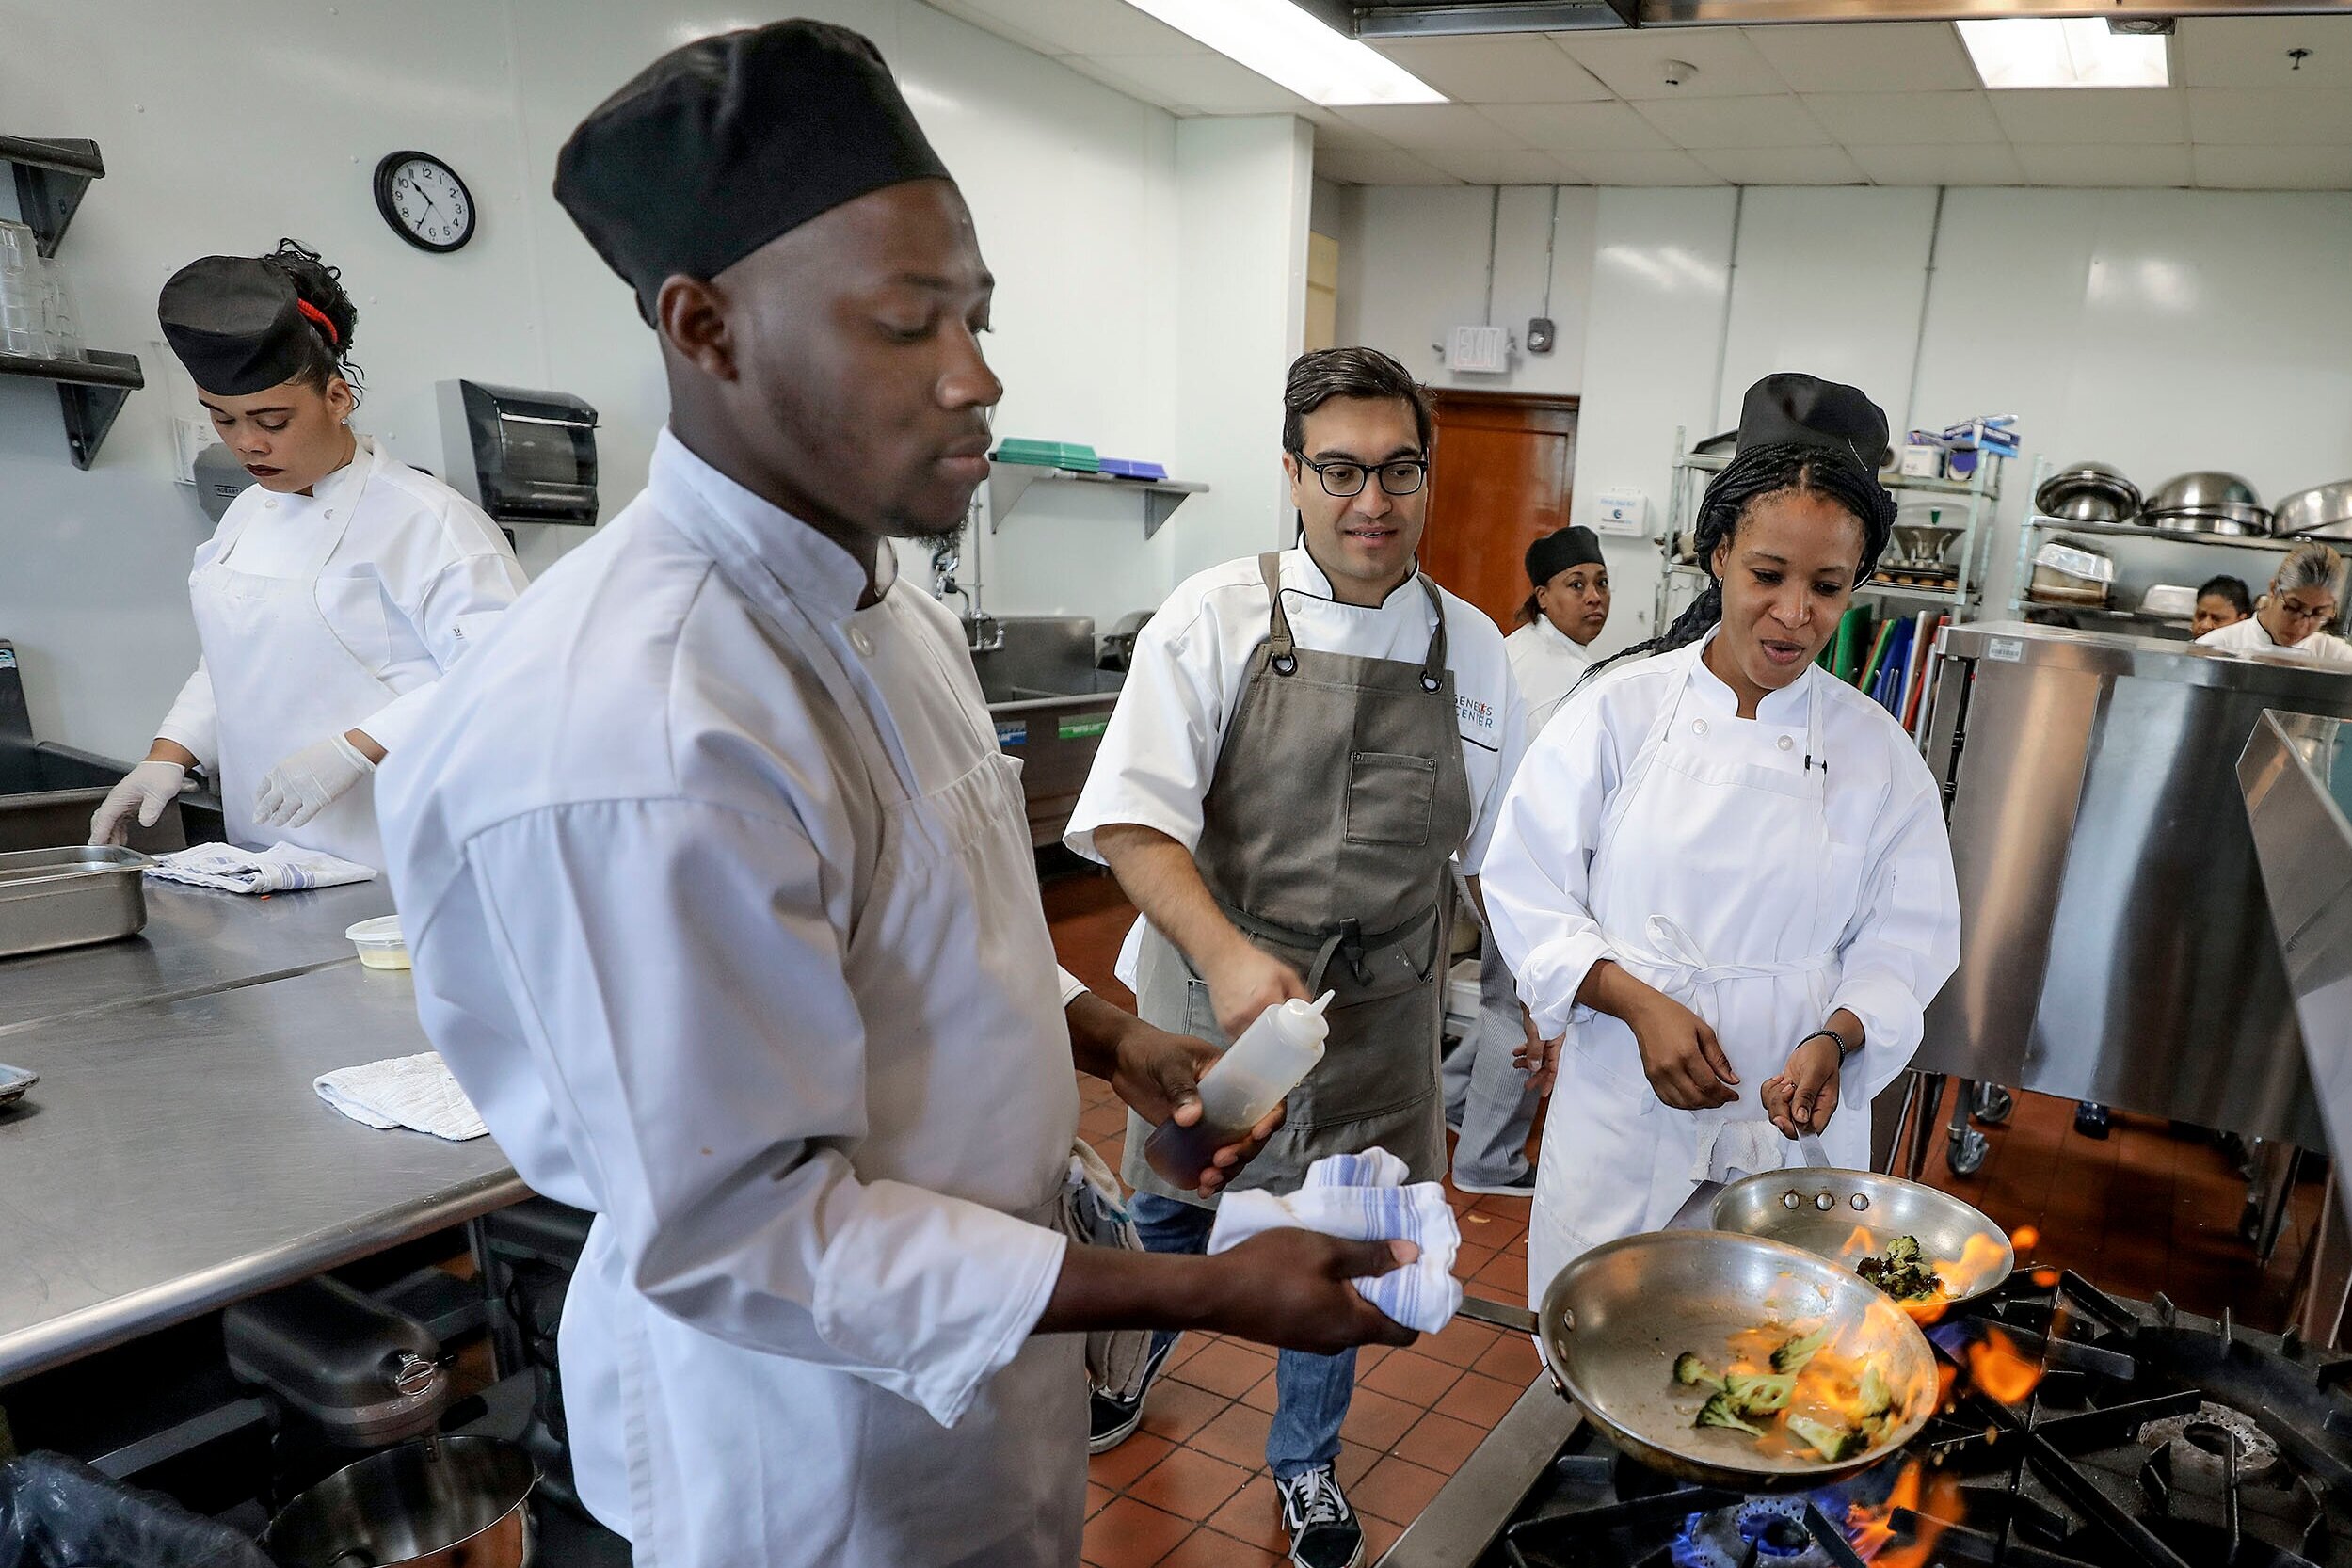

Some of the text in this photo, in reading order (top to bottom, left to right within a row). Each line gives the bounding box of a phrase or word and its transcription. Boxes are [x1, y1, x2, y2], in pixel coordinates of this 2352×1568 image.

[408, 168, 414, 179] 11
[422, 168, 432, 180] 12
[398, 177, 408, 188] 10
[439, 175, 442, 184] 1
[395, 190, 403, 201] 9
[449, 188, 456, 199] 2
[402, 206, 409, 218] 8
[456, 204, 461, 214] 3
[452, 217, 459, 227] 4
[429, 227, 436, 237] 6
[443, 225, 451, 236] 5
[1455, 327, 1499, 367] EXIT
